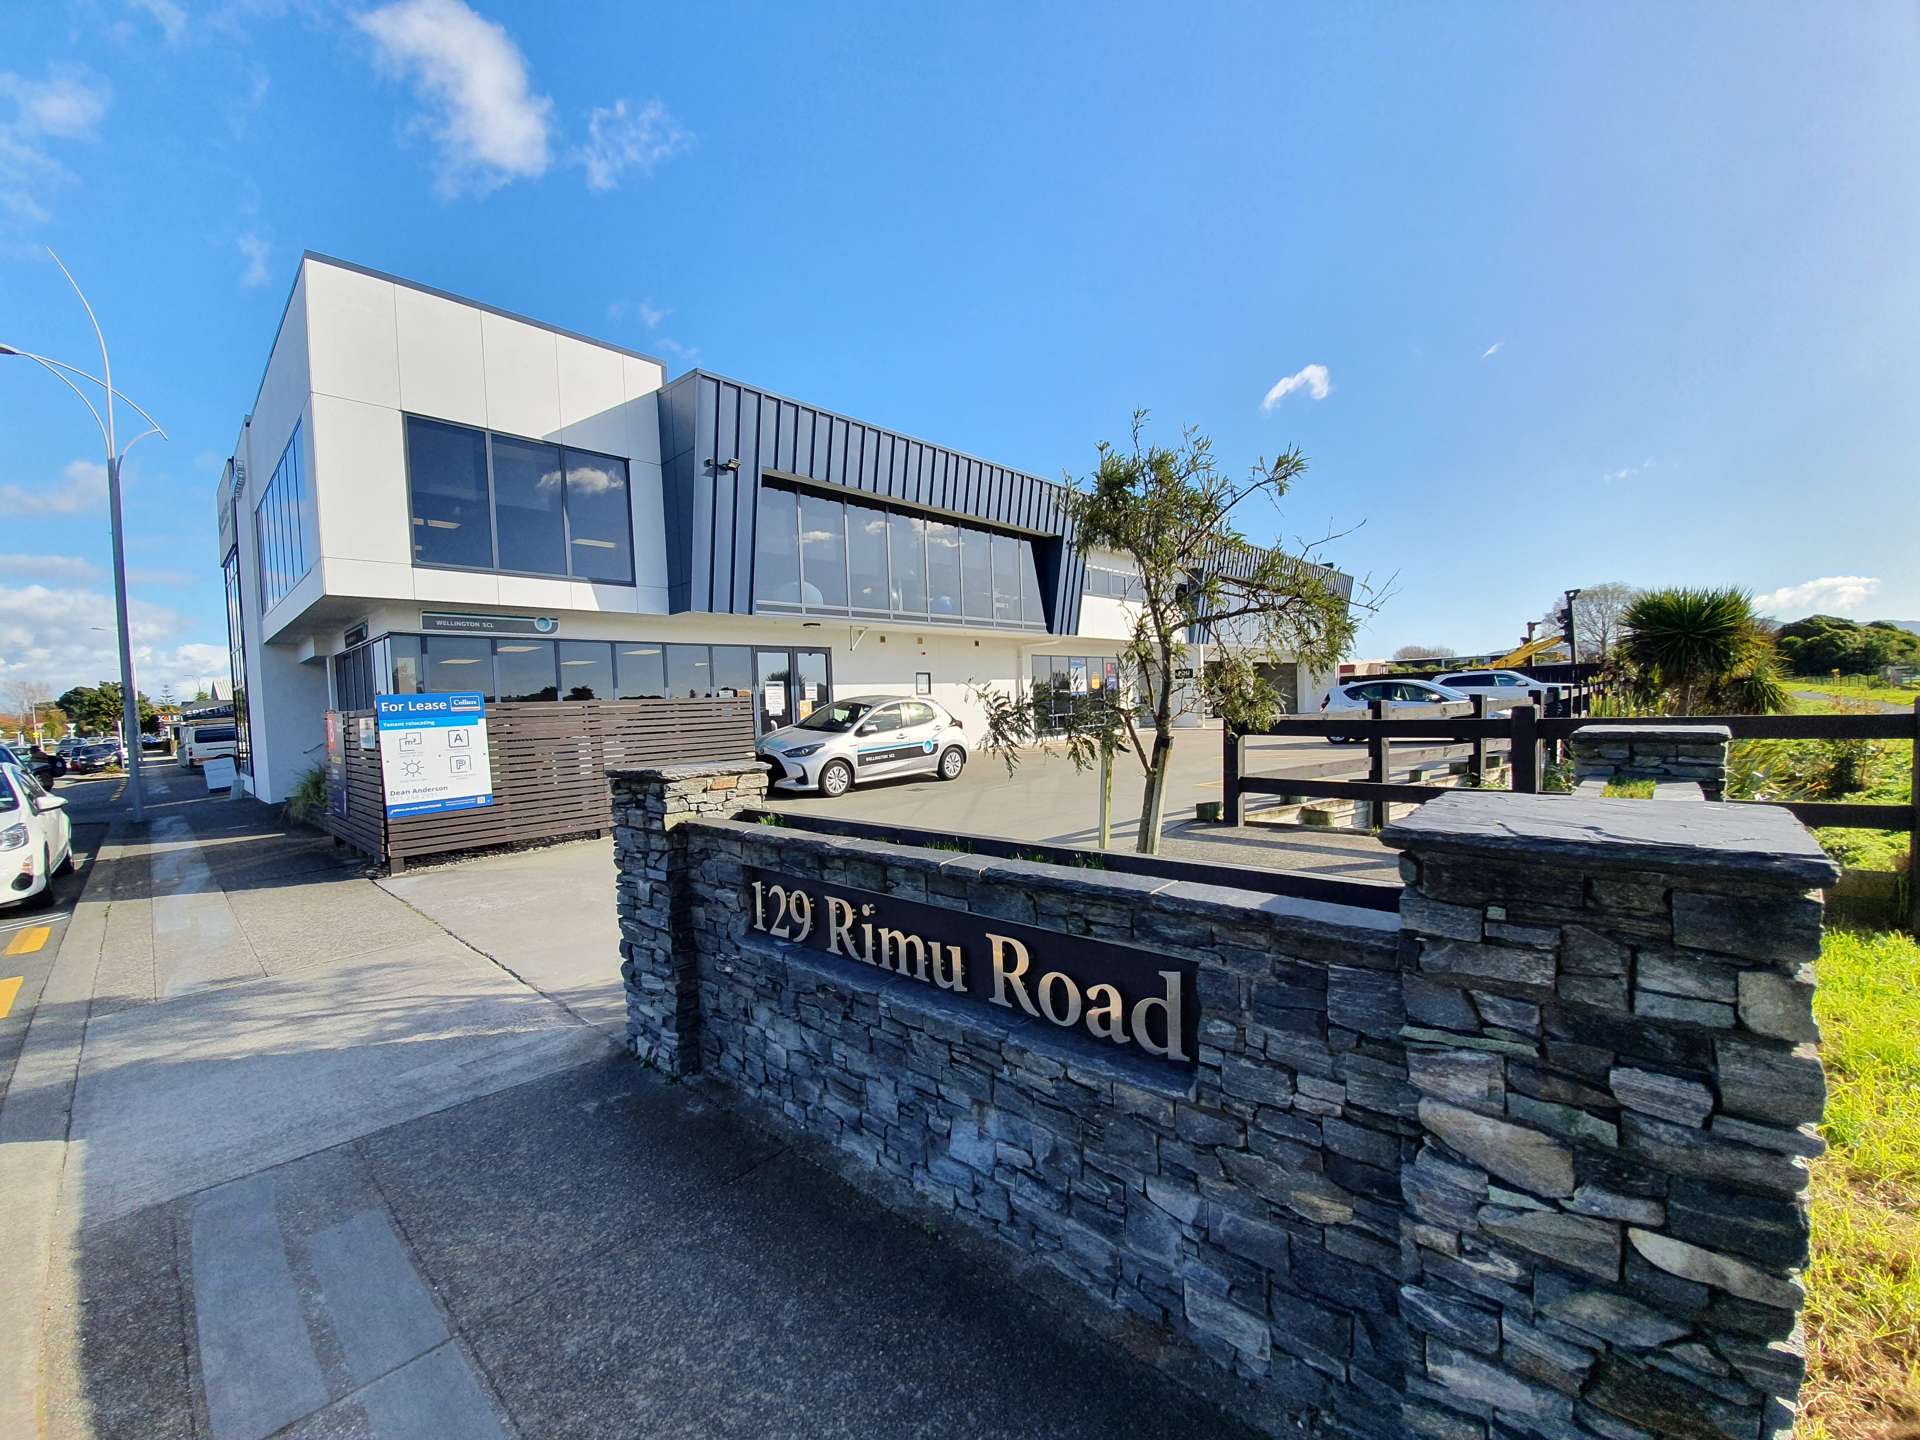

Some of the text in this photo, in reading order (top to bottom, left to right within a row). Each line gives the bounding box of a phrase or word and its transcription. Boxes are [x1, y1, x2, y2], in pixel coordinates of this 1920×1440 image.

[185, 706, 233, 717] SPECTRU
[381, 701, 447, 712] For Lease
[390, 789, 411, 797] Dean
[412, 785, 448, 794] Anderson
[752, 880, 1190, 1062] 129 Rimu Road
